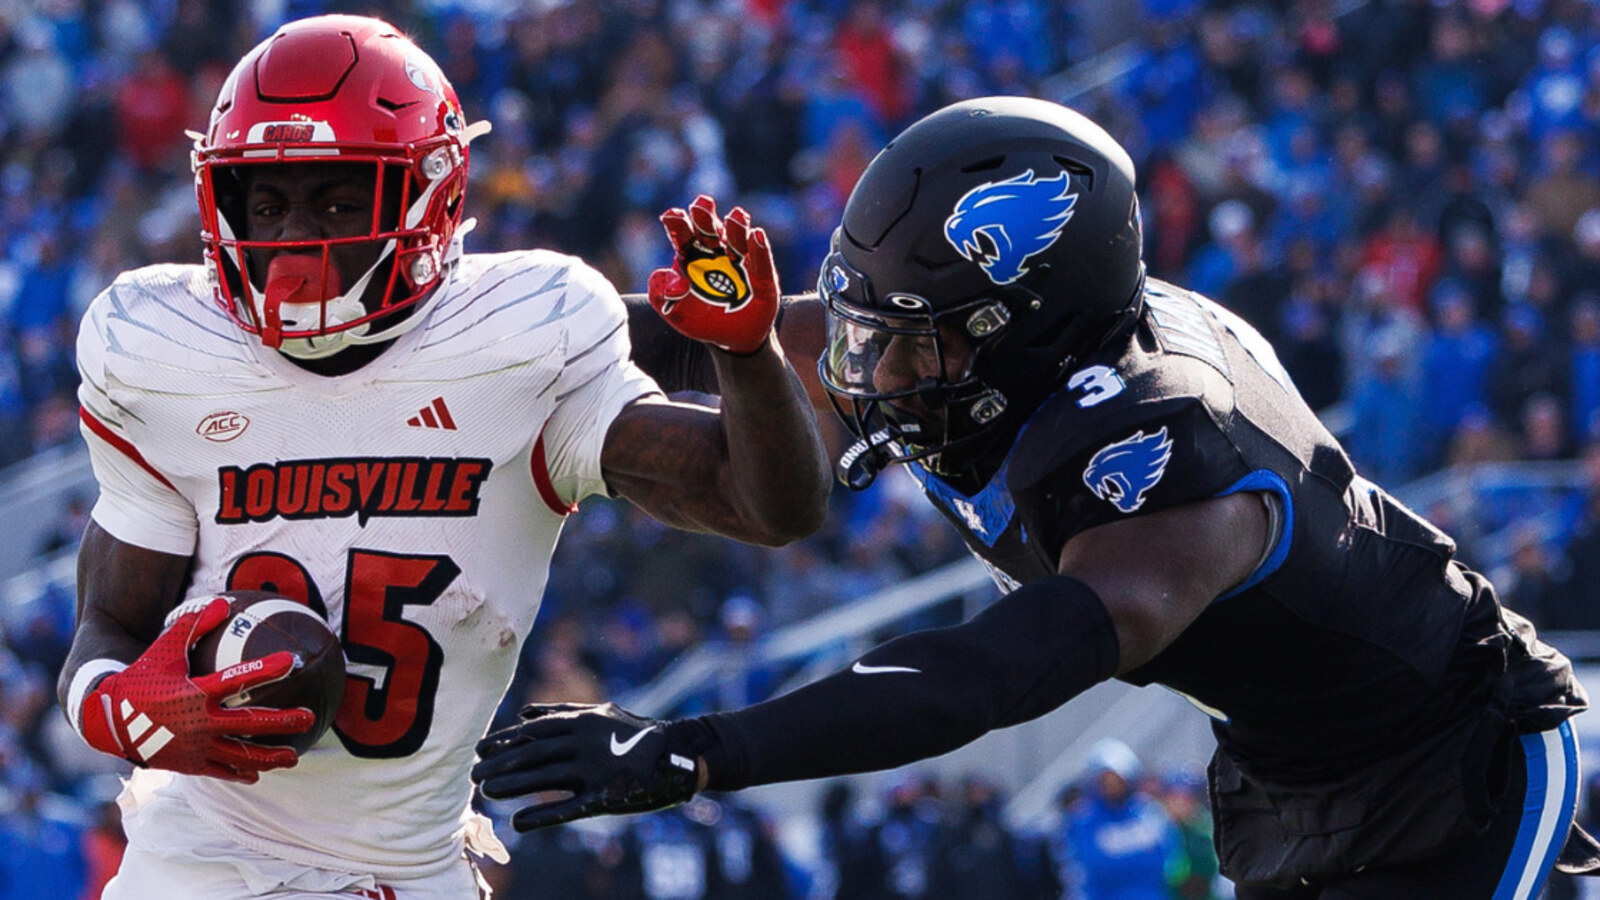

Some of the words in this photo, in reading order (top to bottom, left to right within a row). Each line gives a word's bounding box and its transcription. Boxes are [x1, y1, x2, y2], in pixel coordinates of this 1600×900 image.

[263, 124, 315, 142] CARDS
[1066, 365, 1126, 409] 3
[204, 415, 241, 435] ACC
[215, 457, 493, 528] LOUISVILLE
[221, 659, 264, 682] ADIZERO
